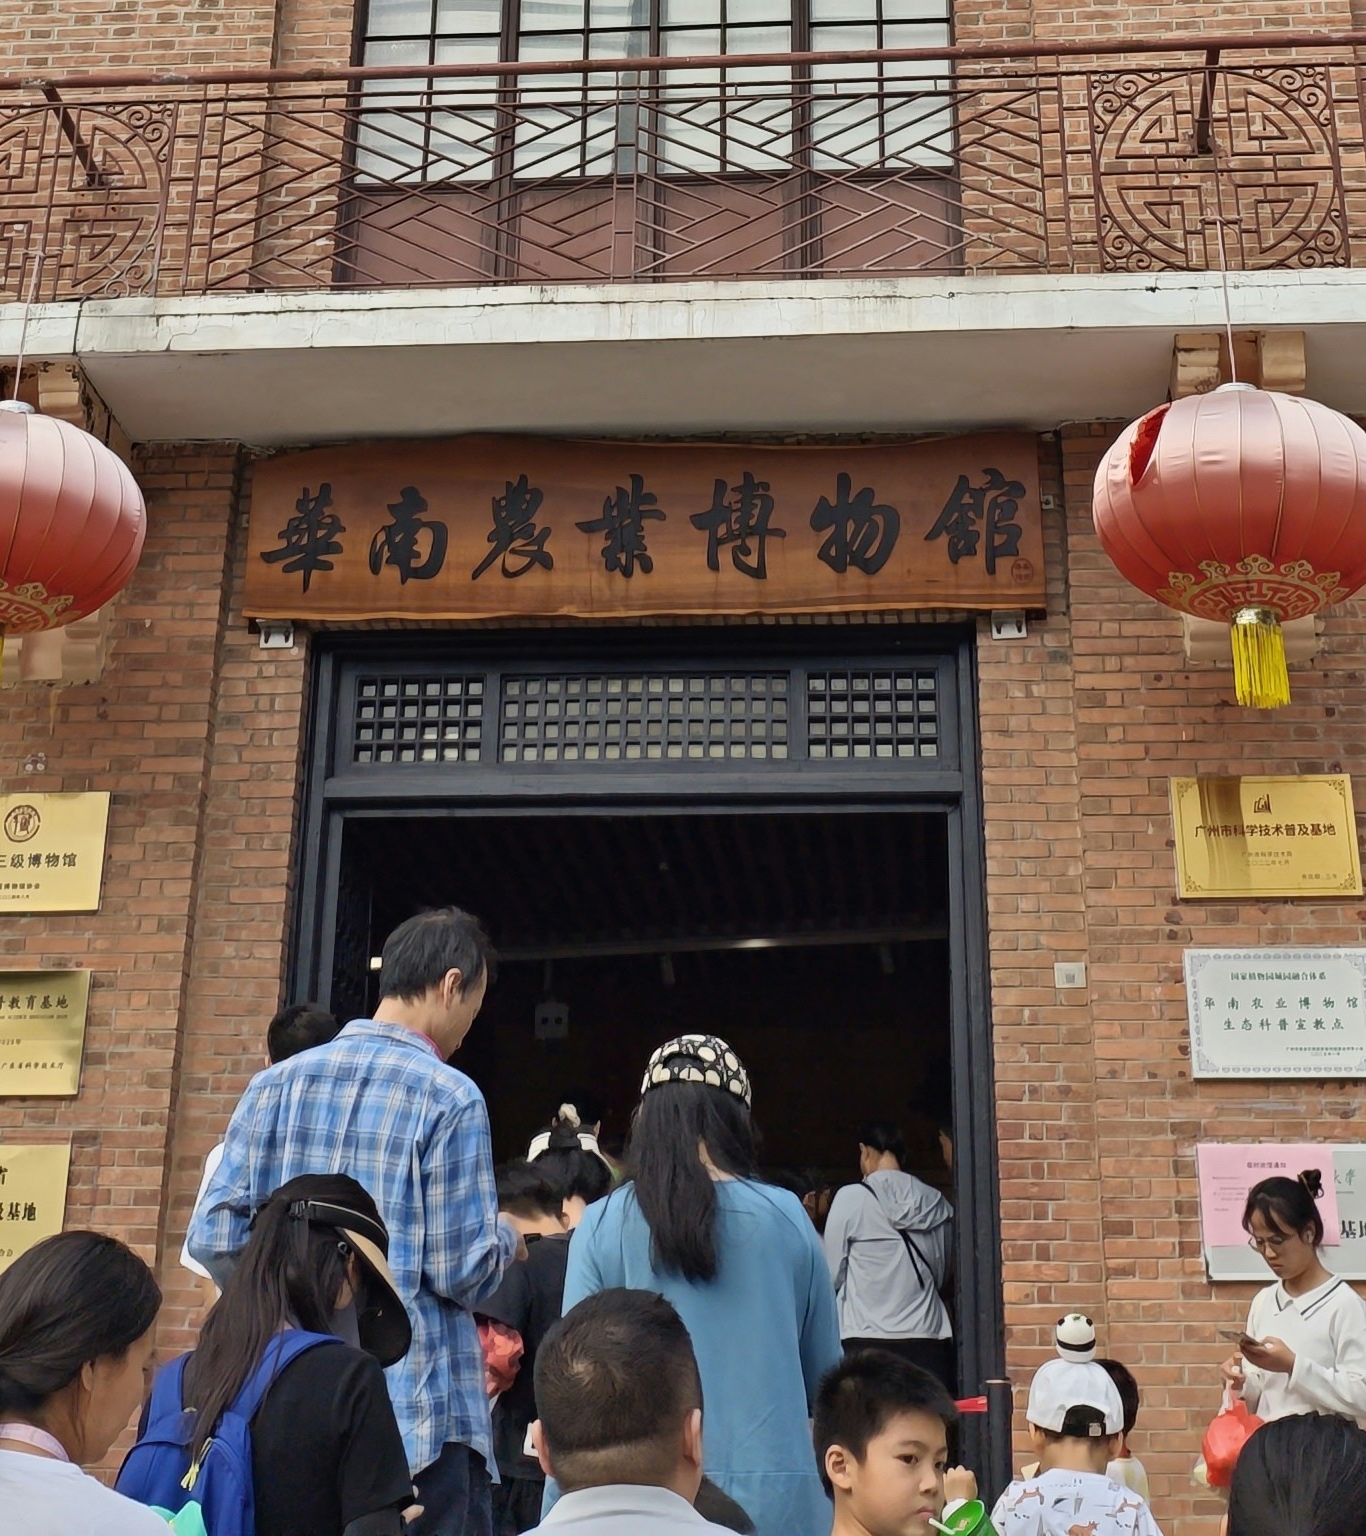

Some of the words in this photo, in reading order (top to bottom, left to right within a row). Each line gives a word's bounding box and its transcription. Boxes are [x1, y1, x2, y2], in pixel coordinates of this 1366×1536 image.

[1195, 823, 1336, 837] 广州市科学技术普及基地
[1203, 996, 1359, 1010] 华南农业博物馆
[1223, 1017, 1345, 1031] 生态科普宣教点
